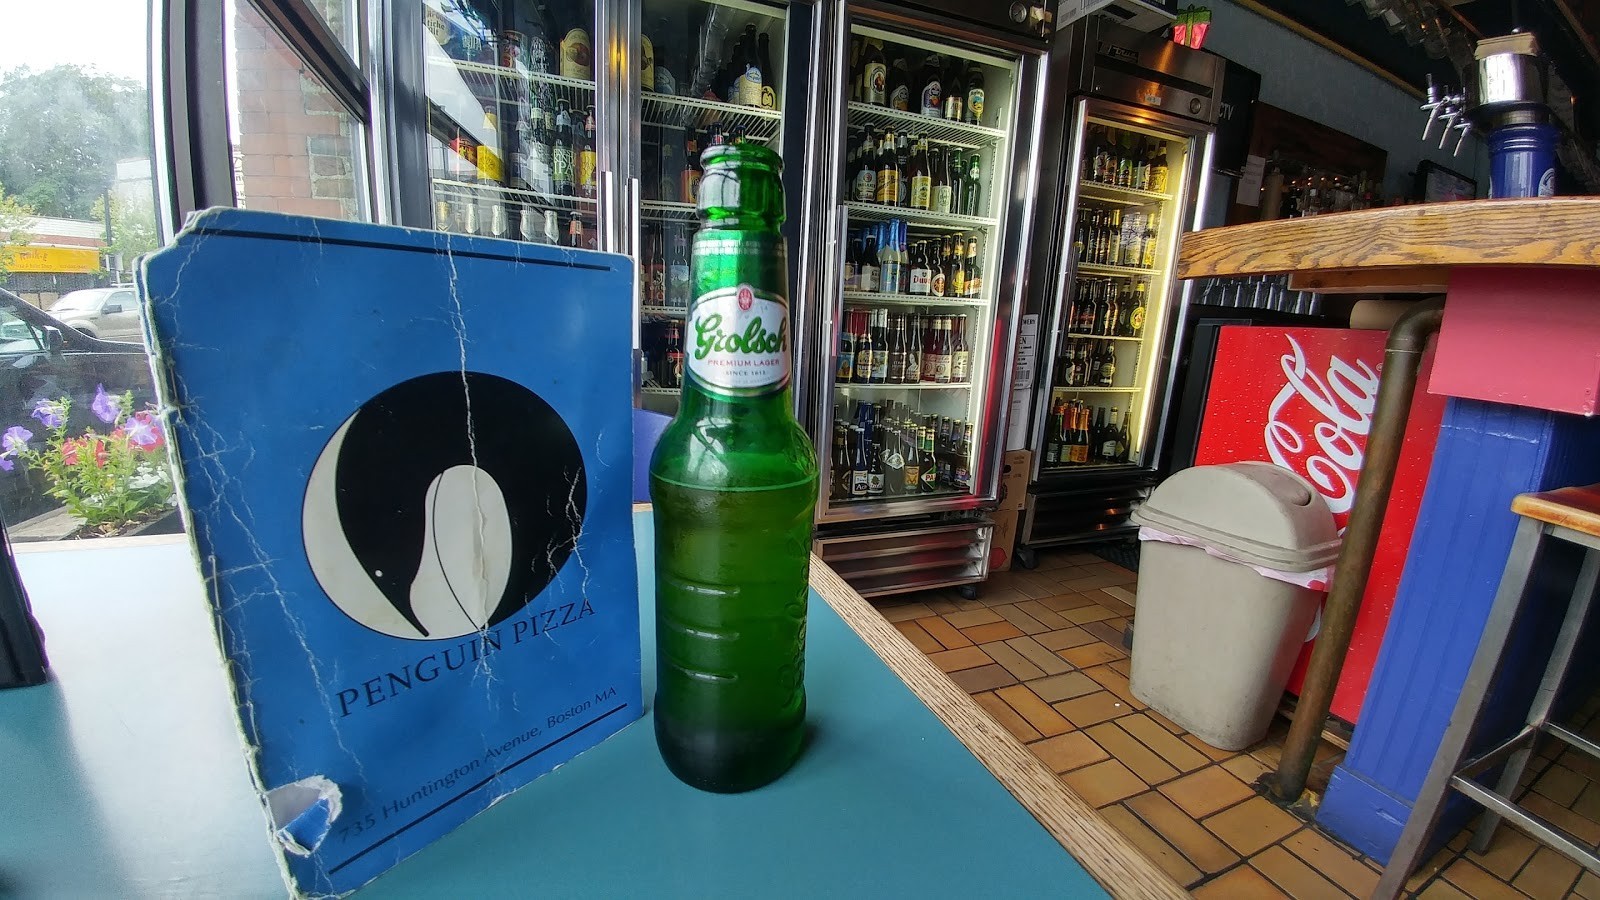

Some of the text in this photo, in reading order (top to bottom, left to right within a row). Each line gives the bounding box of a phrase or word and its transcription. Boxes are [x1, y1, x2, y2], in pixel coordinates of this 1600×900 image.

[694, 312, 788, 360] Grolsch
[336, 599, 596, 718] PENGUIN PIZZA
[339, 686, 618, 844] 735 Huntington Avenue, Boston MA
